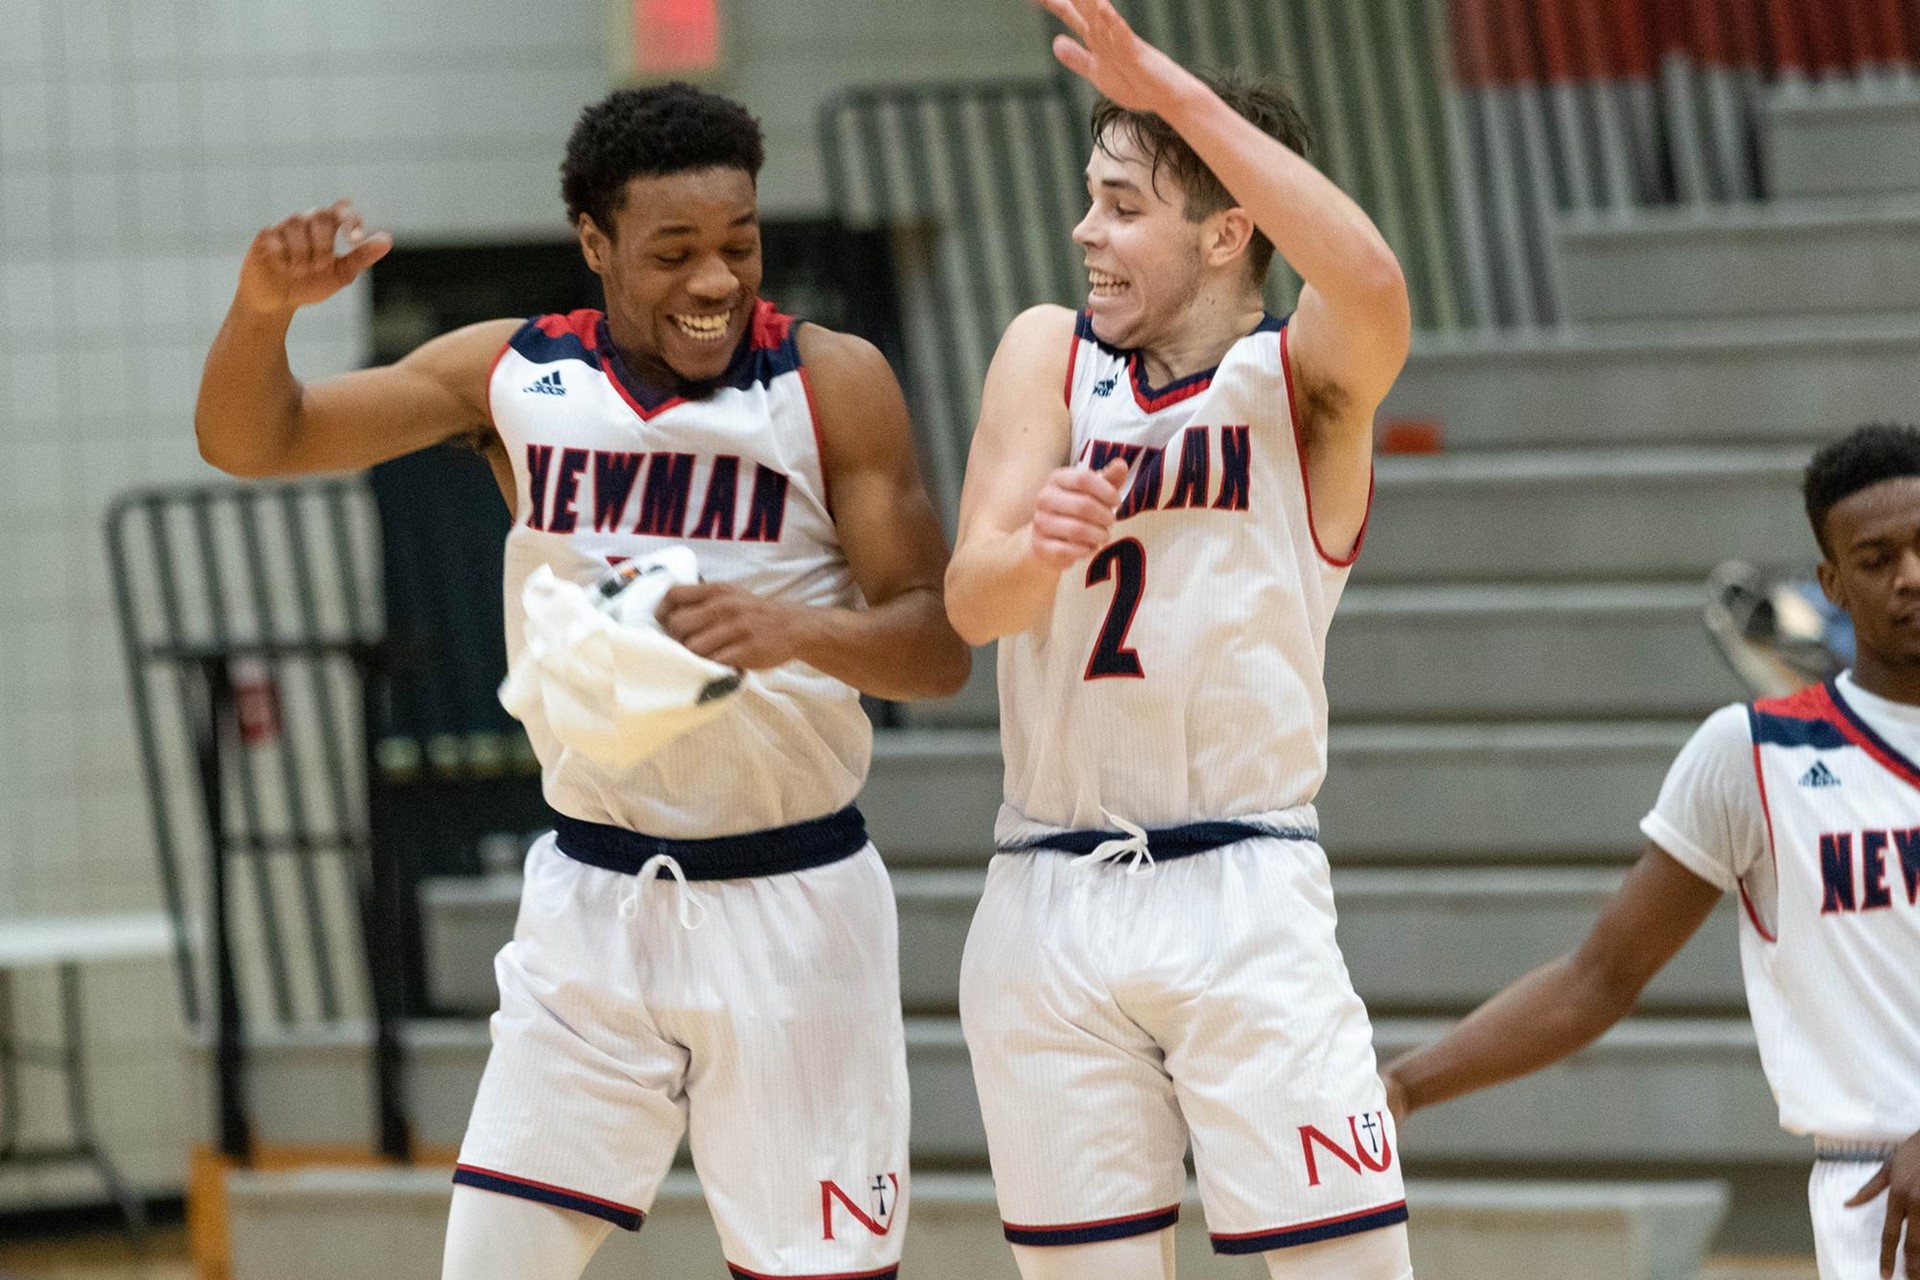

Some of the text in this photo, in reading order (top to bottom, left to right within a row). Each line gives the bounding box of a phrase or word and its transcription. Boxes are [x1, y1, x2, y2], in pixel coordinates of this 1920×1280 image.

[526, 443, 789, 542] NEWMAN
[1083, 536, 1145, 681] 2
[1297, 1111, 1392, 1186] NU
